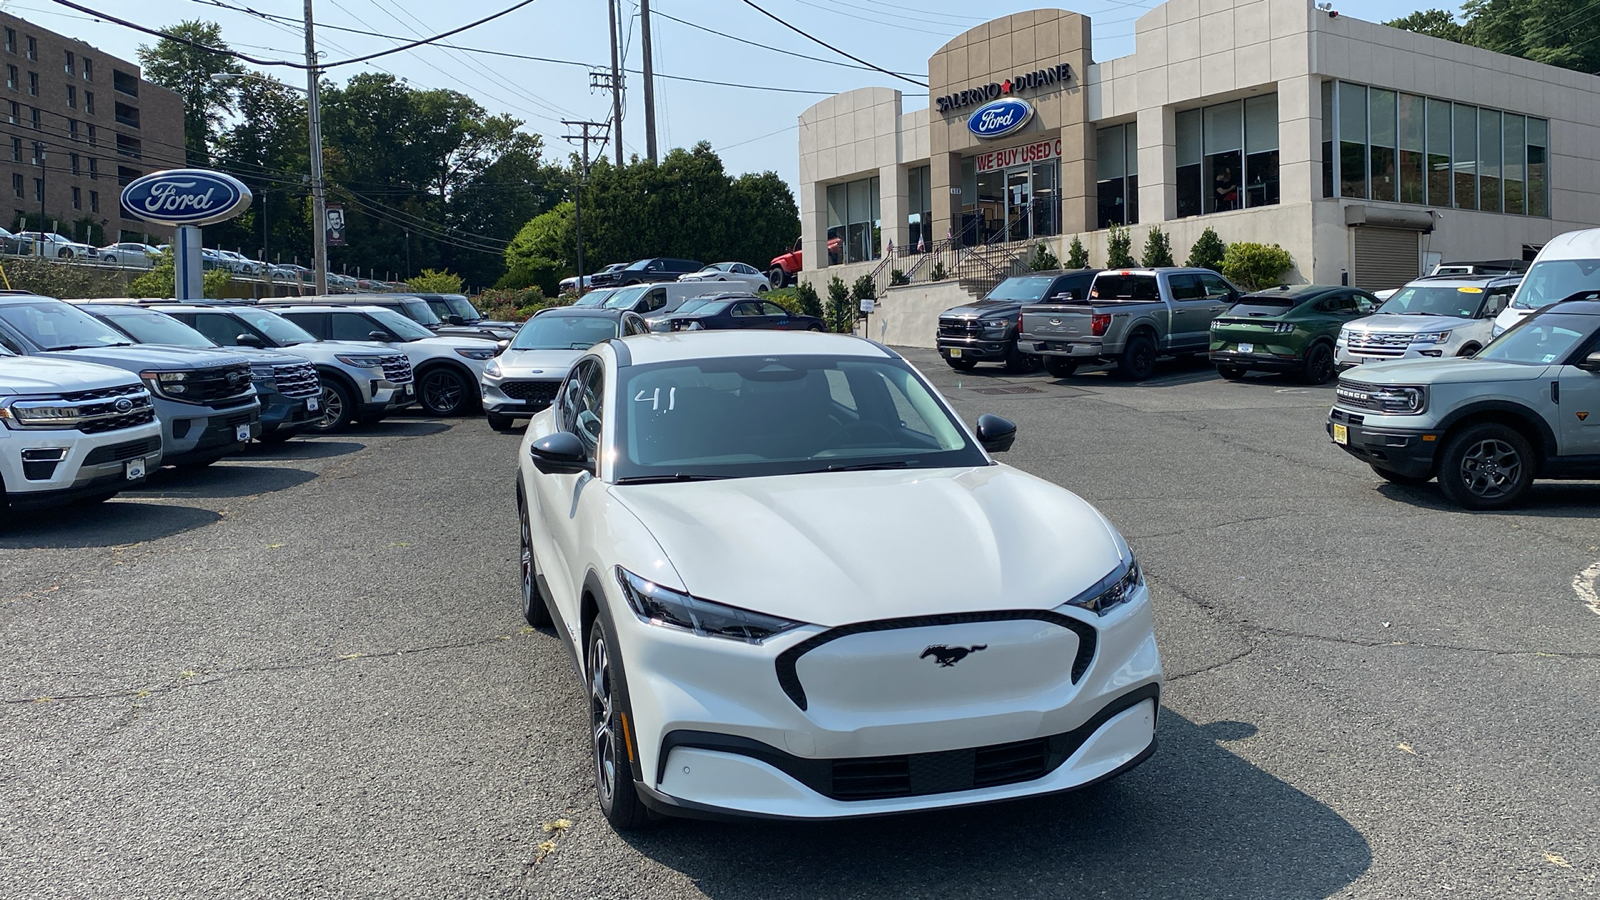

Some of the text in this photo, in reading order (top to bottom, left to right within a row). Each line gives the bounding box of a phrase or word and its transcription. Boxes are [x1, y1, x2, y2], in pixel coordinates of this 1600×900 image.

[936, 63, 1071, 112] SALERNO DUANE
[979, 107, 1014, 132] Ford
[977, 153, 993, 171] WE
[996, 148, 1018, 168] BUY
[1021, 142, 1051, 163] USED
[145, 181, 215, 211] Ford
[634, 386, 676, 411] 41
[1336, 388, 1368, 400] BRONCO
